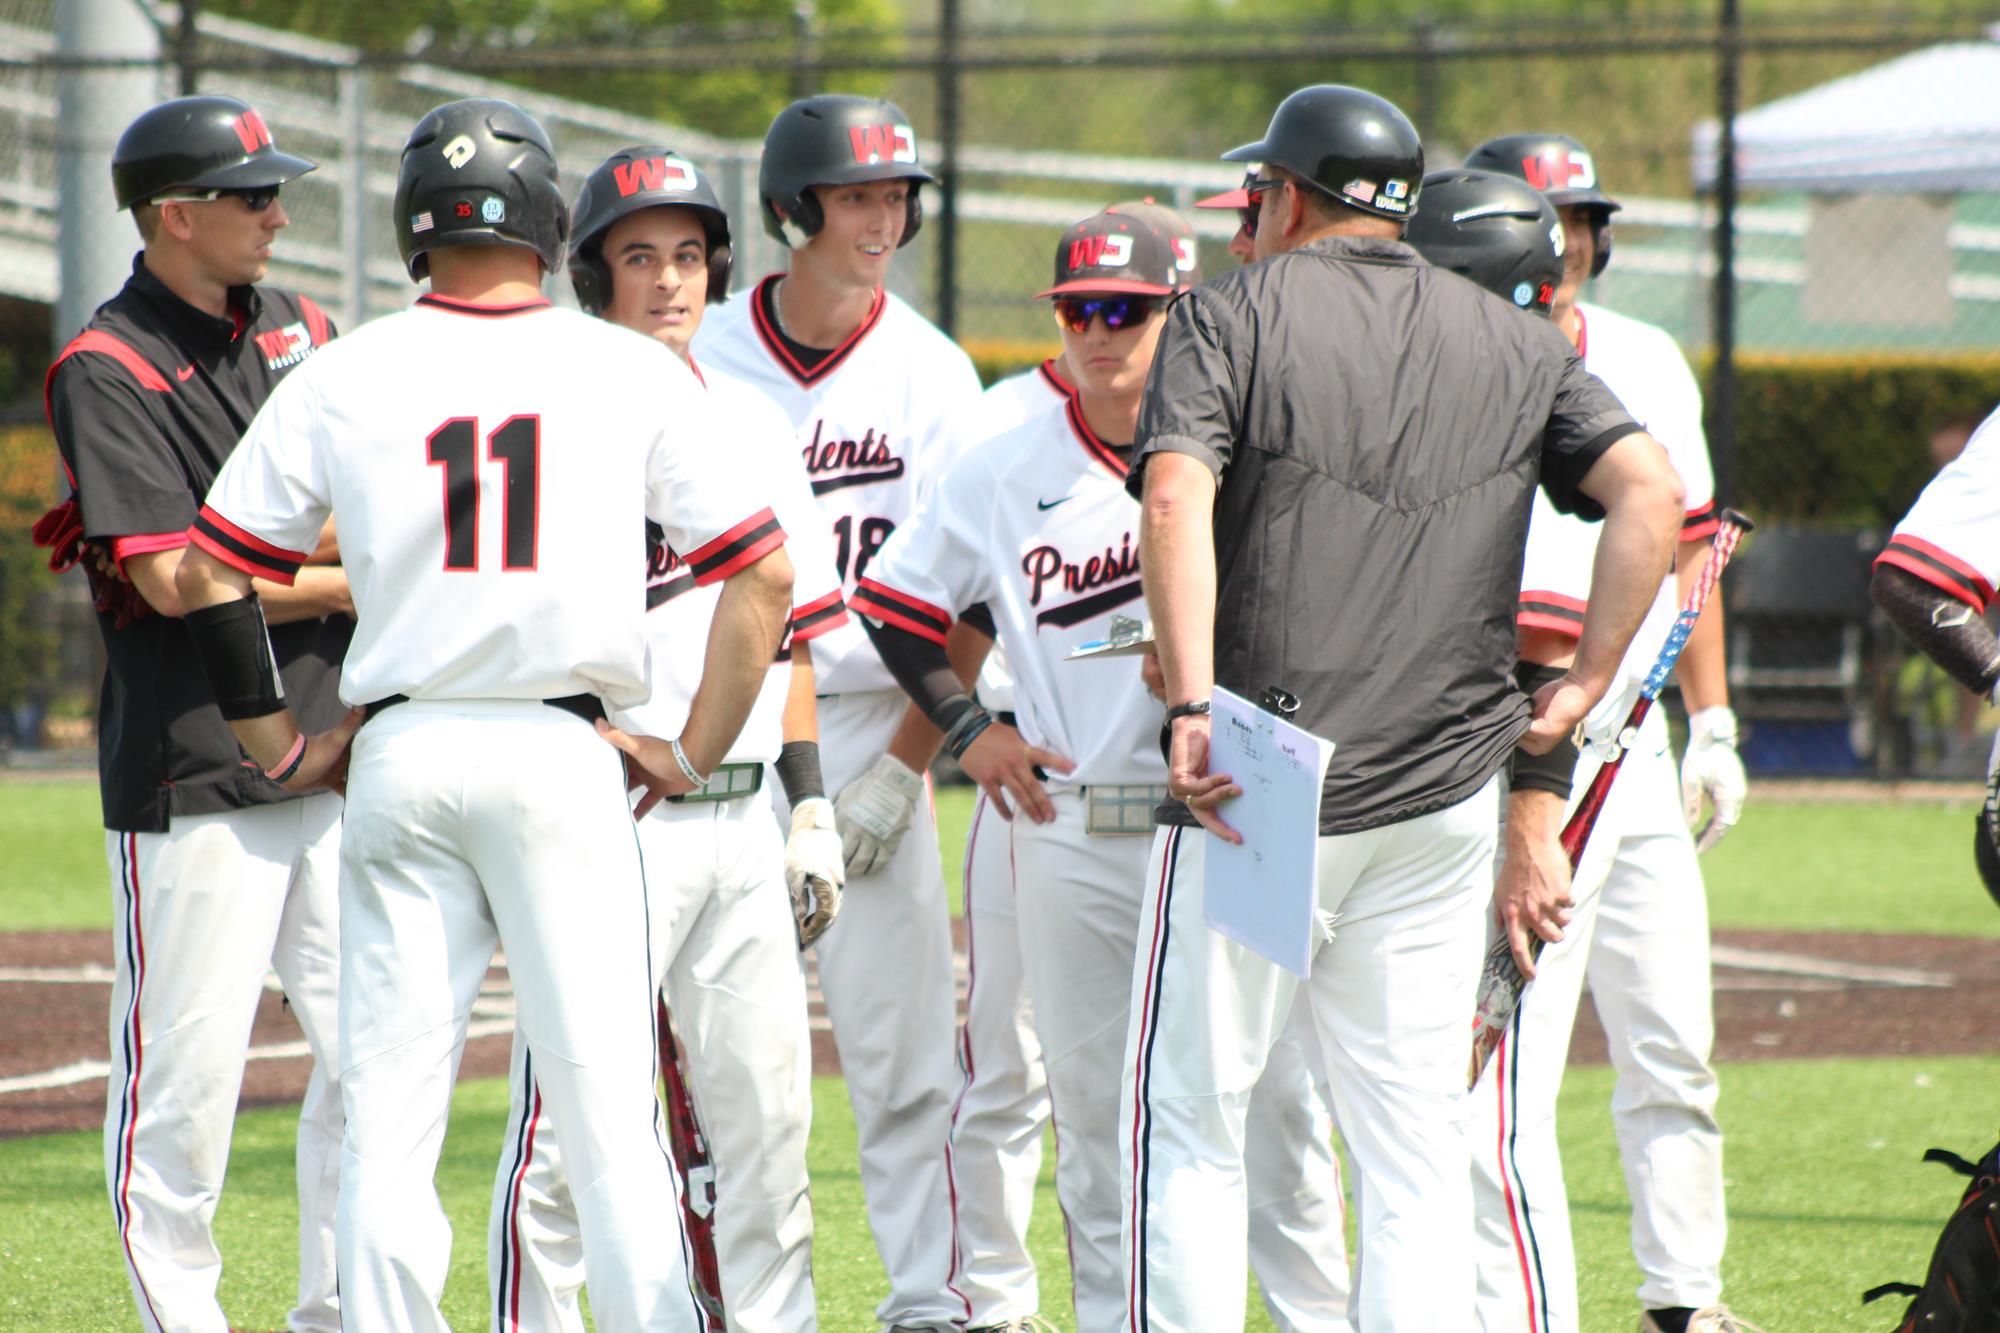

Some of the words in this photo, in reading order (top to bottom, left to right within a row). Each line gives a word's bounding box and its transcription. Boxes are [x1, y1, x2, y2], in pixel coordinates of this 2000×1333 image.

[456, 204, 472, 217] 35
[425, 413, 541, 573] 11
[834, 514, 896, 586] 18
